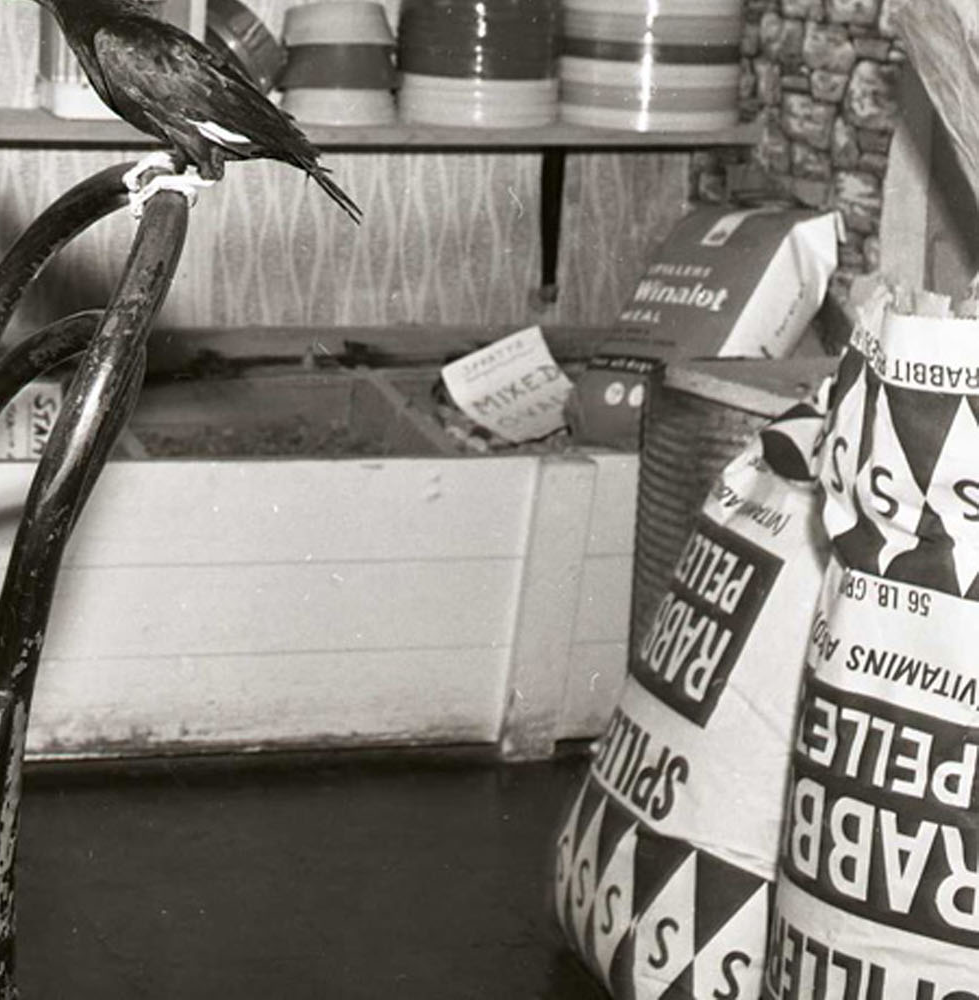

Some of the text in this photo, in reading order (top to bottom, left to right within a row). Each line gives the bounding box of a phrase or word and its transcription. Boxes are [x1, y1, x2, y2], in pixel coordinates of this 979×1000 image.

[649, 263, 712, 278] SPILLERS
[633, 280, 729, 312] Winalot
[621, 309, 663, 325] MEAL
[473, 364, 561, 416] MIXED
[891, 359, 979, 389] RABBIT
[869, 465, 899, 520] S
[873, 581, 899, 611] LB.
[907, 589, 932, 618] 56
[601, 884, 621, 935] S
[647, 916, 680, 970] S
[712, 950, 752, 1000] S
